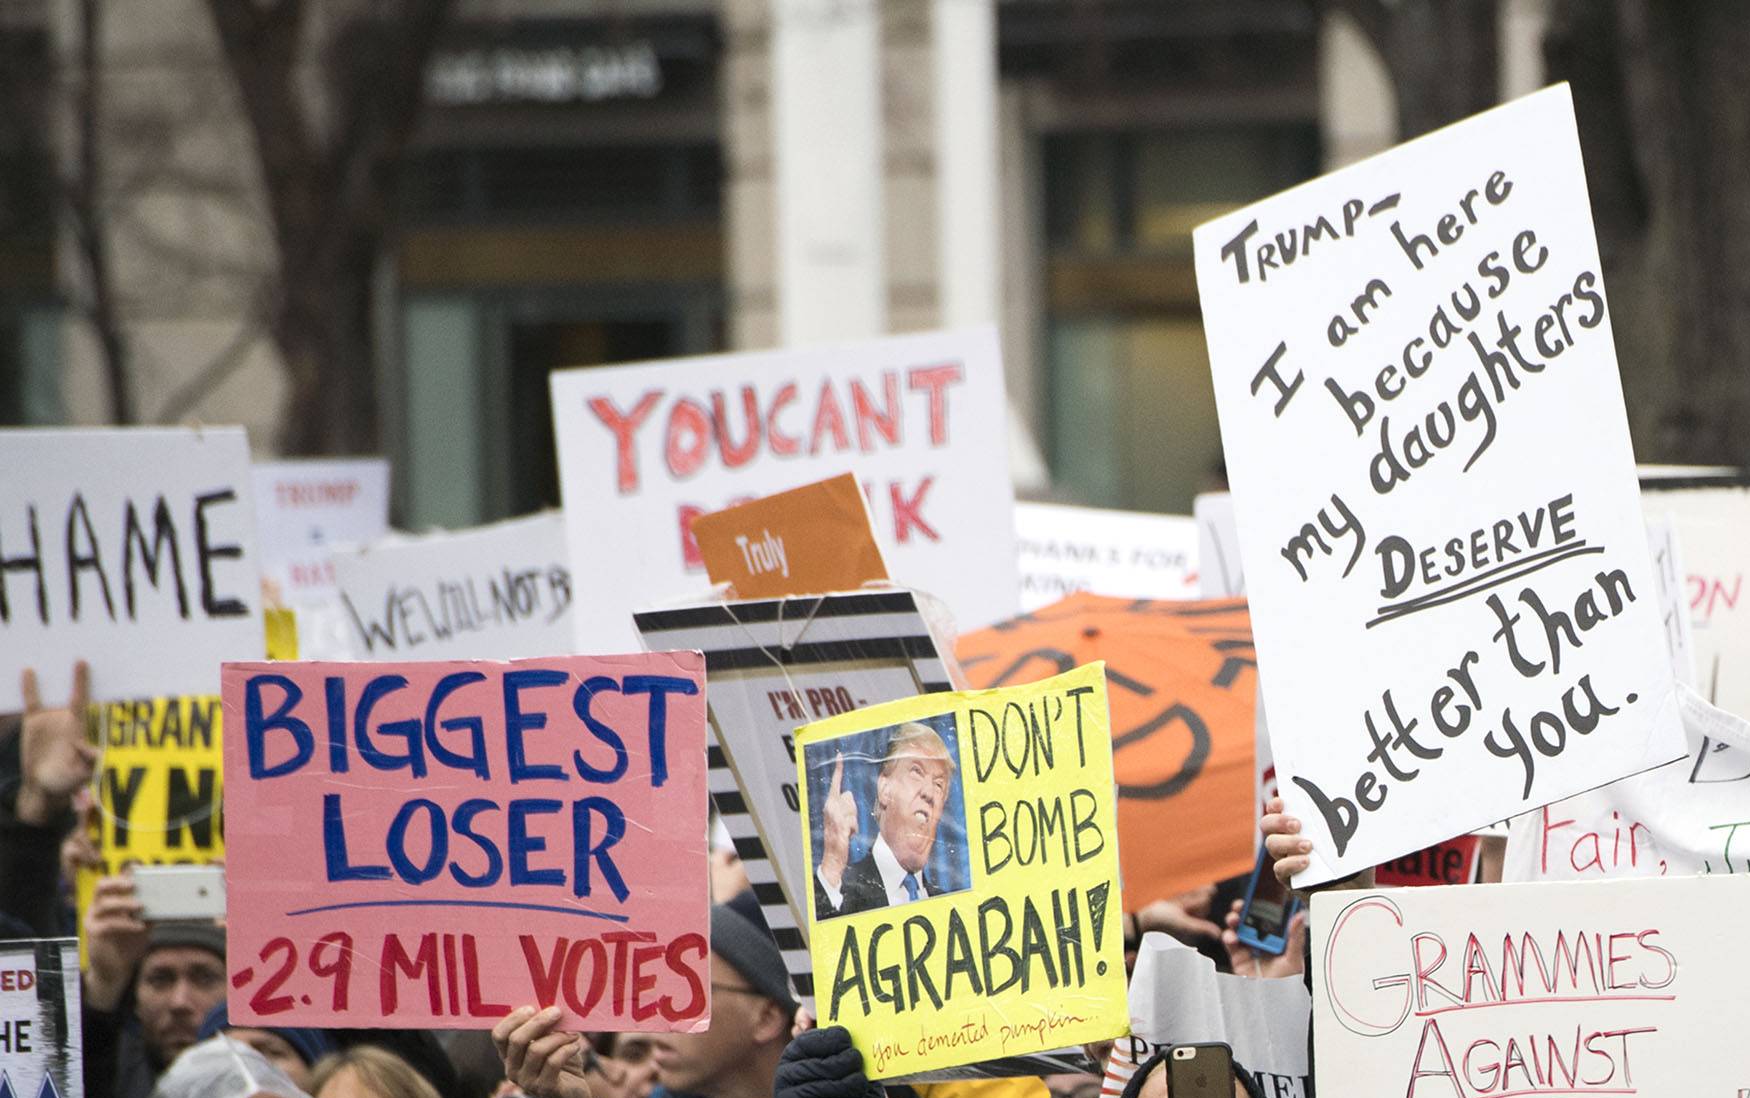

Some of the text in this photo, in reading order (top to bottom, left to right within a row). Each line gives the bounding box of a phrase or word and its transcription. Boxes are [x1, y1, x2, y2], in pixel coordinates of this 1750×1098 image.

[1250, 169, 1514, 418] I am here
[1323, 226, 1549, 436] because
[1280, 269, 1606, 584] my daughters
[0, 490, 252, 624] HAME
[735, 527, 790, 579] Truly
[1375, 492, 1578, 600] DESERVE
[244, 669, 701, 788] BIGGEST
[969, 686, 1096, 784] DON'T
[1291, 650, 1482, 858] better
[1487, 561, 1638, 676] than
[1483, 671, 1638, 801] you.
[321, 791, 632, 905] LOSER
[979, 788, 1106, 876] BOMB
[231, 931, 708, 1022] -2.9 MIL VOTES
[829, 879, 1112, 1023] AGRABAH!
[1324, 894, 1678, 1038] GRAMMIES
[872, 1042, 912, 1074] you
